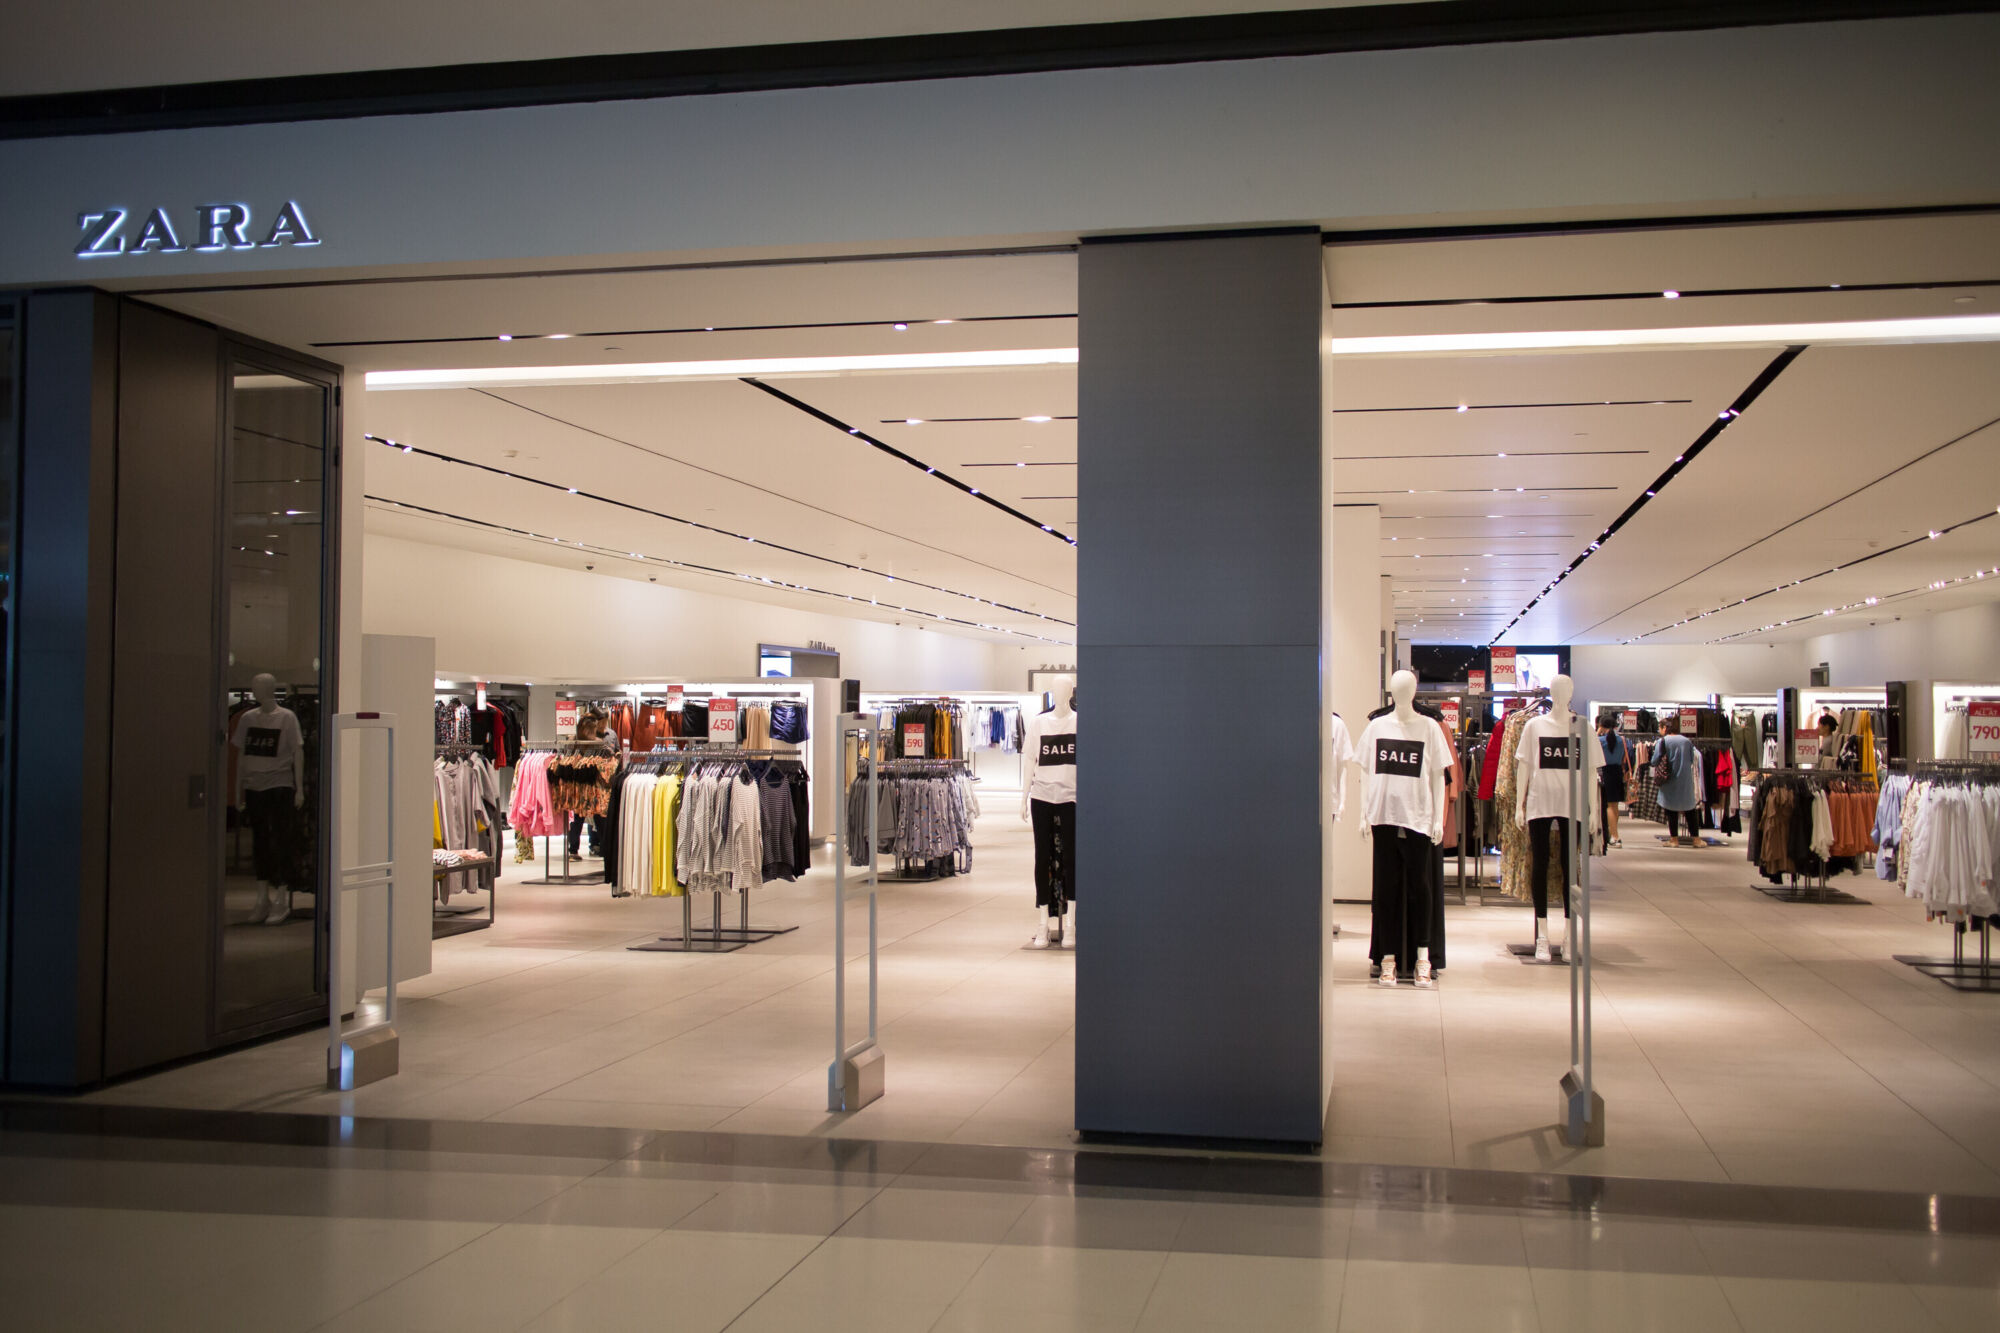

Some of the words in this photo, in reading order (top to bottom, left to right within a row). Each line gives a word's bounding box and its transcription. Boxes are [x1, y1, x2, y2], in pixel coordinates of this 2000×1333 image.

[75, 200, 322, 259] ZARA
[1494, 665, 1516, 674] 2990
[558, 717, 575, 726] 350
[712, 718, 735, 731] 450
[906, 739, 923, 748] 590
[1042, 744, 1075, 755] SALE
[1379, 749, 1419, 764] SALE
